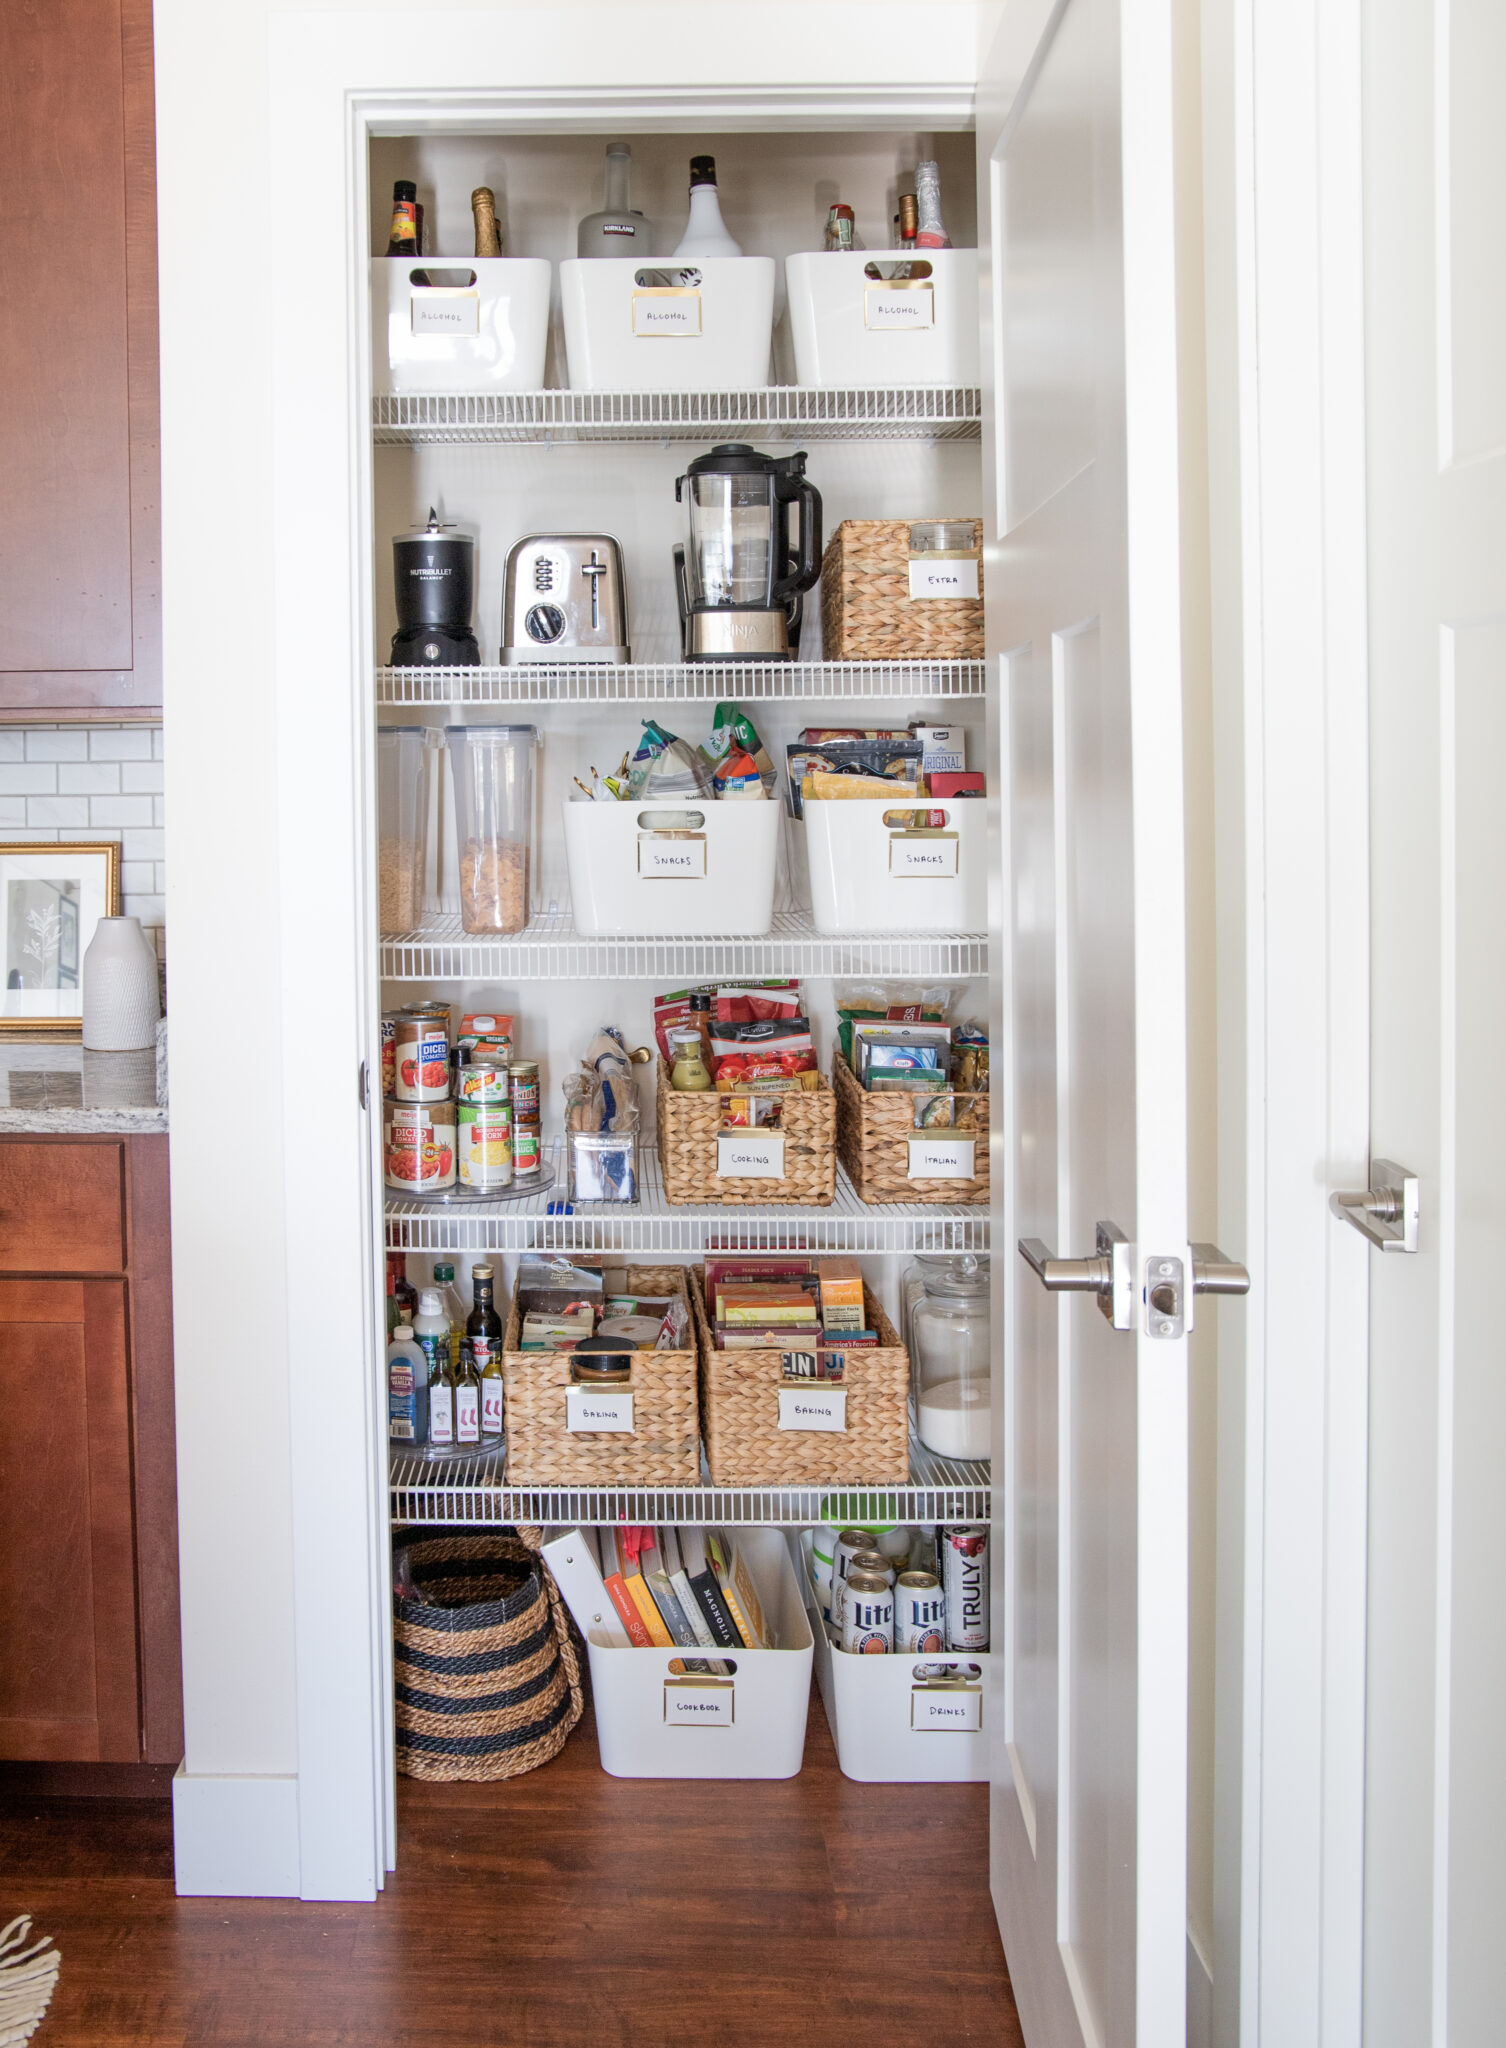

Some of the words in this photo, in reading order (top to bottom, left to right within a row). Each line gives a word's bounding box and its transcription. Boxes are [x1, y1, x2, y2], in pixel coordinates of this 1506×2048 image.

[604, 225, 635, 233] KIRKLAND
[878, 306, 919, 315] ALCOHOL
[421, 311, 462, 321] ALCOHOL
[646, 312, 688, 321] ALCOHOL
[410, 568, 453, 576] NUTRIBULLET
[723, 623, 759, 639] NINJA
[654, 855, 691, 866] SNACKS
[906, 854, 943, 864] SNACKS
[423, 1044, 447, 1055] DICED
[762, 1082, 791, 1090] RIPENED
[395, 1128, 428, 1138] DICED
[731, 1154, 769, 1164] COOKING
[925, 1156, 957, 1165] ITALIAN
[852, 1340, 877, 1348] Favorite
[583, 1408, 618, 1419] BAKING
[794, 1405, 832, 1416] BAKING
[962, 1560, 981, 1631] TRULY
[703, 1588, 731, 1641] MAGNOLIA
[854, 1601, 893, 1631] Lite
[911, 1600, 946, 1629] Lite
[727, 1597, 742, 1621] EASY
[739, 1623, 753, 1648] KETO
[677, 1702, 721, 1711] COOKBOOK
[929, 1706, 966, 1717] DRINKS
